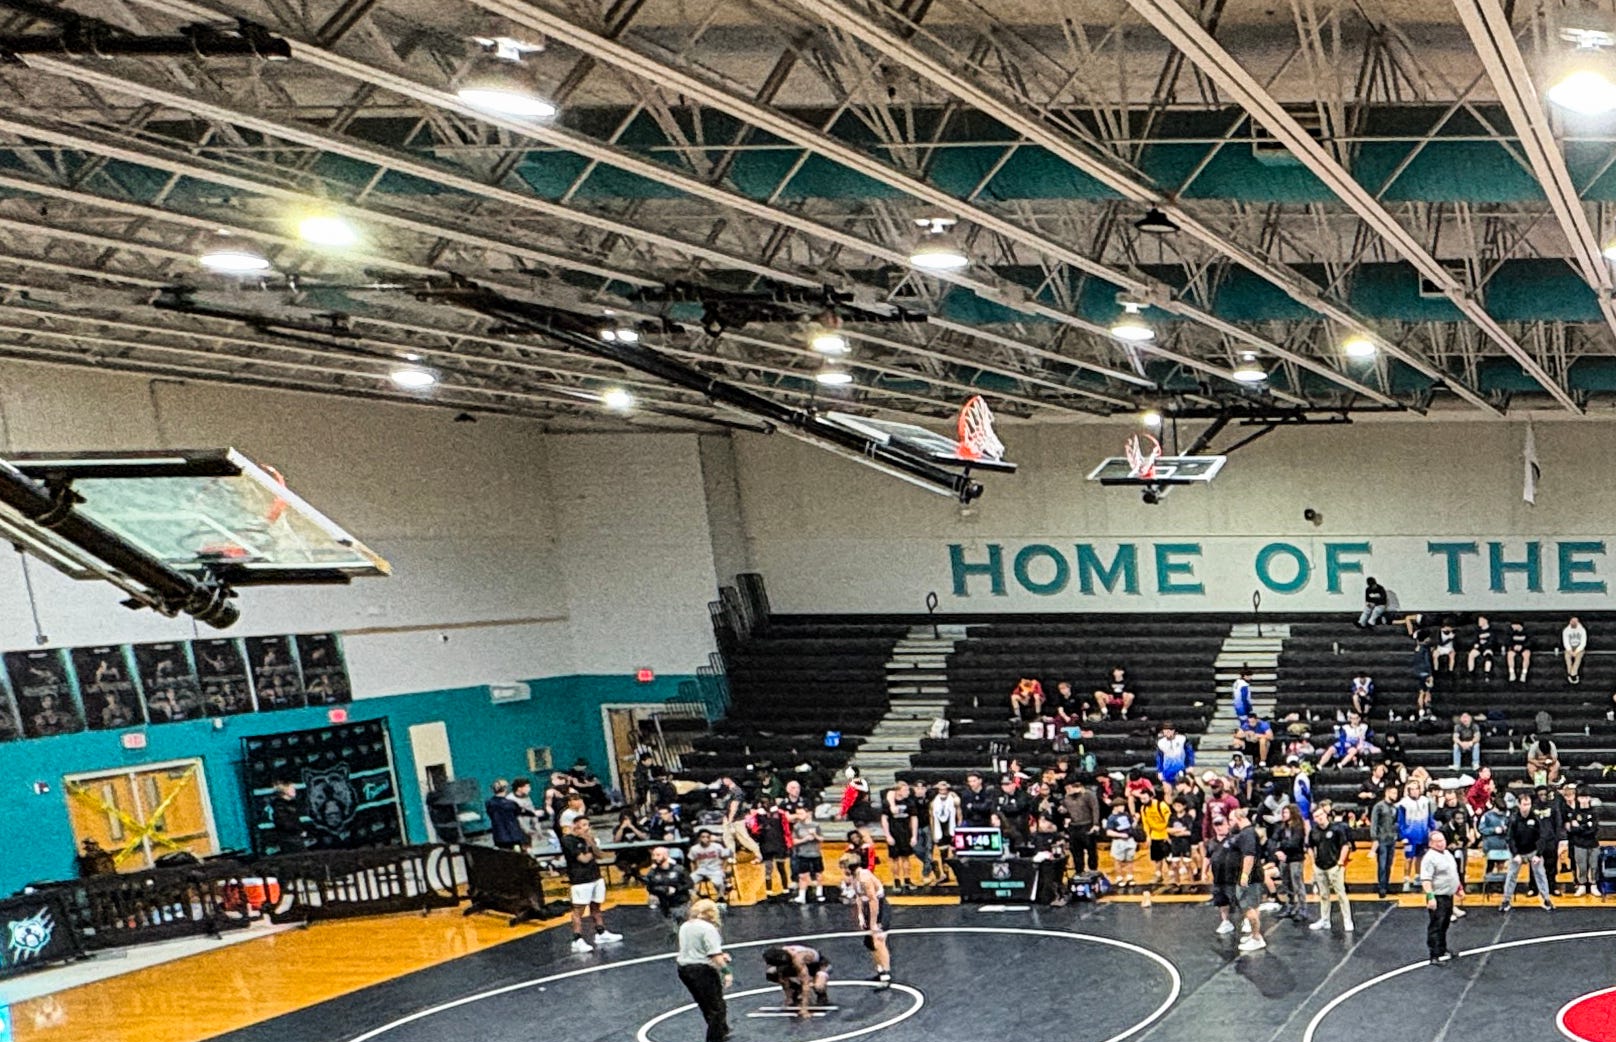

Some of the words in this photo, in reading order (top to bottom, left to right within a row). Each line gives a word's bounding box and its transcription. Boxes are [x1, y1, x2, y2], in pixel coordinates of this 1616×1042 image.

[949, 542, 1205, 595] HOME
[1254, 541, 1373, 595] OF
[1427, 541, 1608, 595] THE
